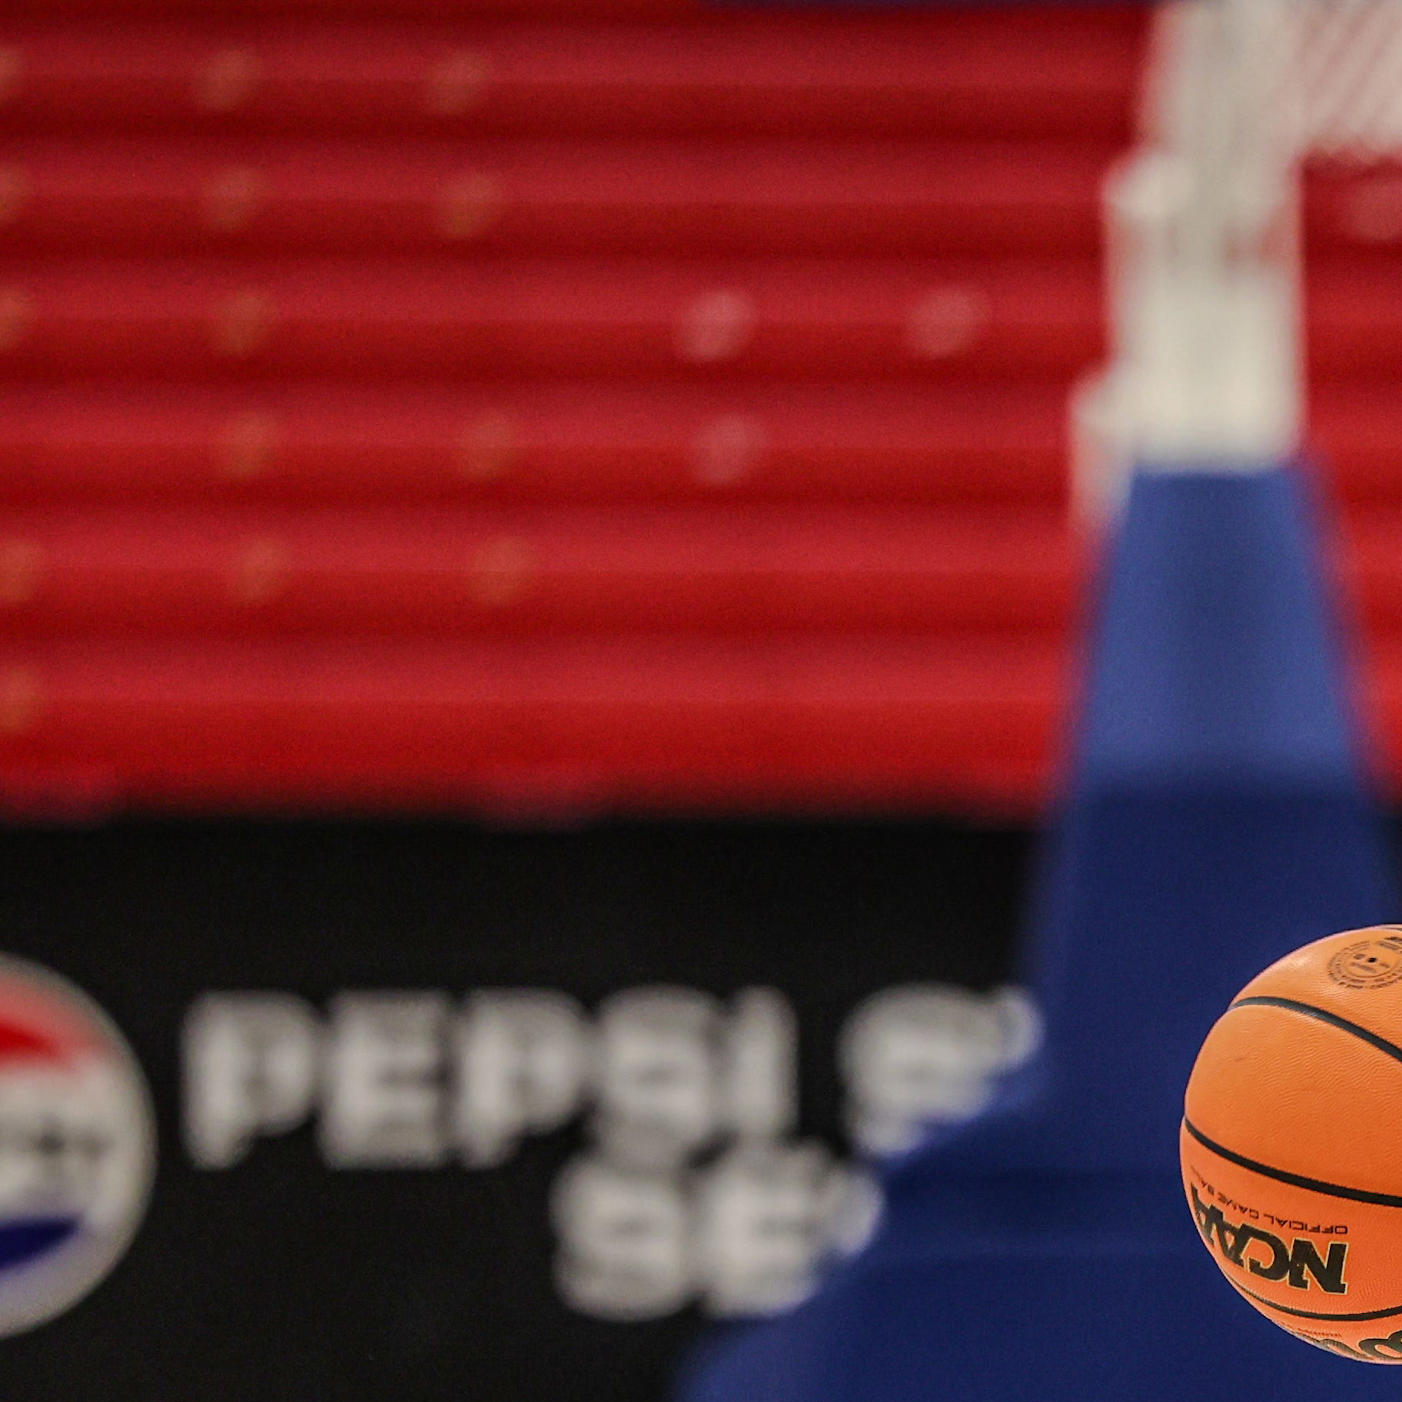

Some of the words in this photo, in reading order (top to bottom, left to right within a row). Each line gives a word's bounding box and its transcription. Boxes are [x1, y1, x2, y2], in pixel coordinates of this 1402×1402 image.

[182, 987, 798, 1170] PEPSI
[1190, 1181, 1350, 1295] NCAA
[1217, 1192, 1260, 1221] GAME
[1263, 1212, 1349, 1236] OFFICIAL
